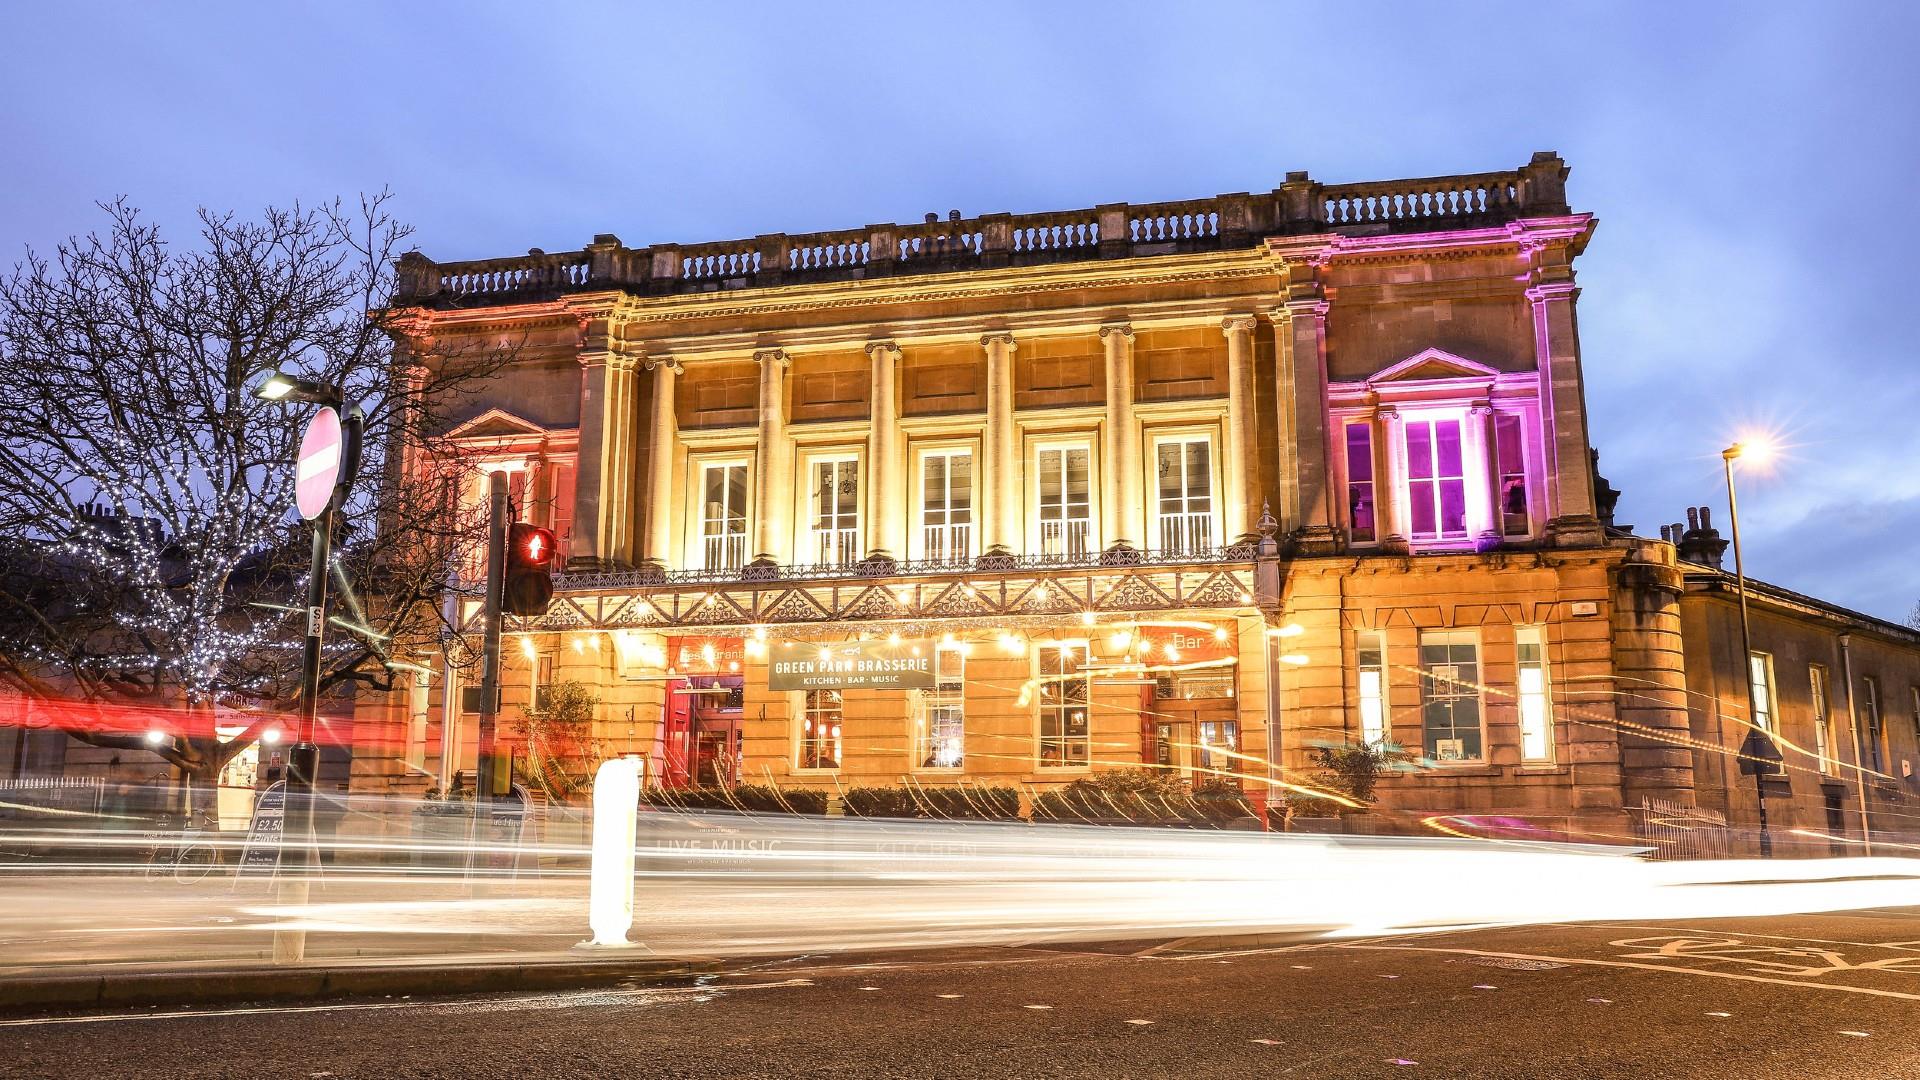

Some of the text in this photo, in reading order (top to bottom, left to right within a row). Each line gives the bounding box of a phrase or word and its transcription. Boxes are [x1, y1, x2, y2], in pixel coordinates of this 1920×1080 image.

[1174, 634, 1205, 649] Bar
[775, 661, 814, 674] GREEN
[858, 658, 928, 672] BRASSERIE
[803, 675, 900, 685] KITCHEN BAR MUSIC
[257, 819, 282, 831] £2.50
[712, 839, 782, 853] MUSIC
